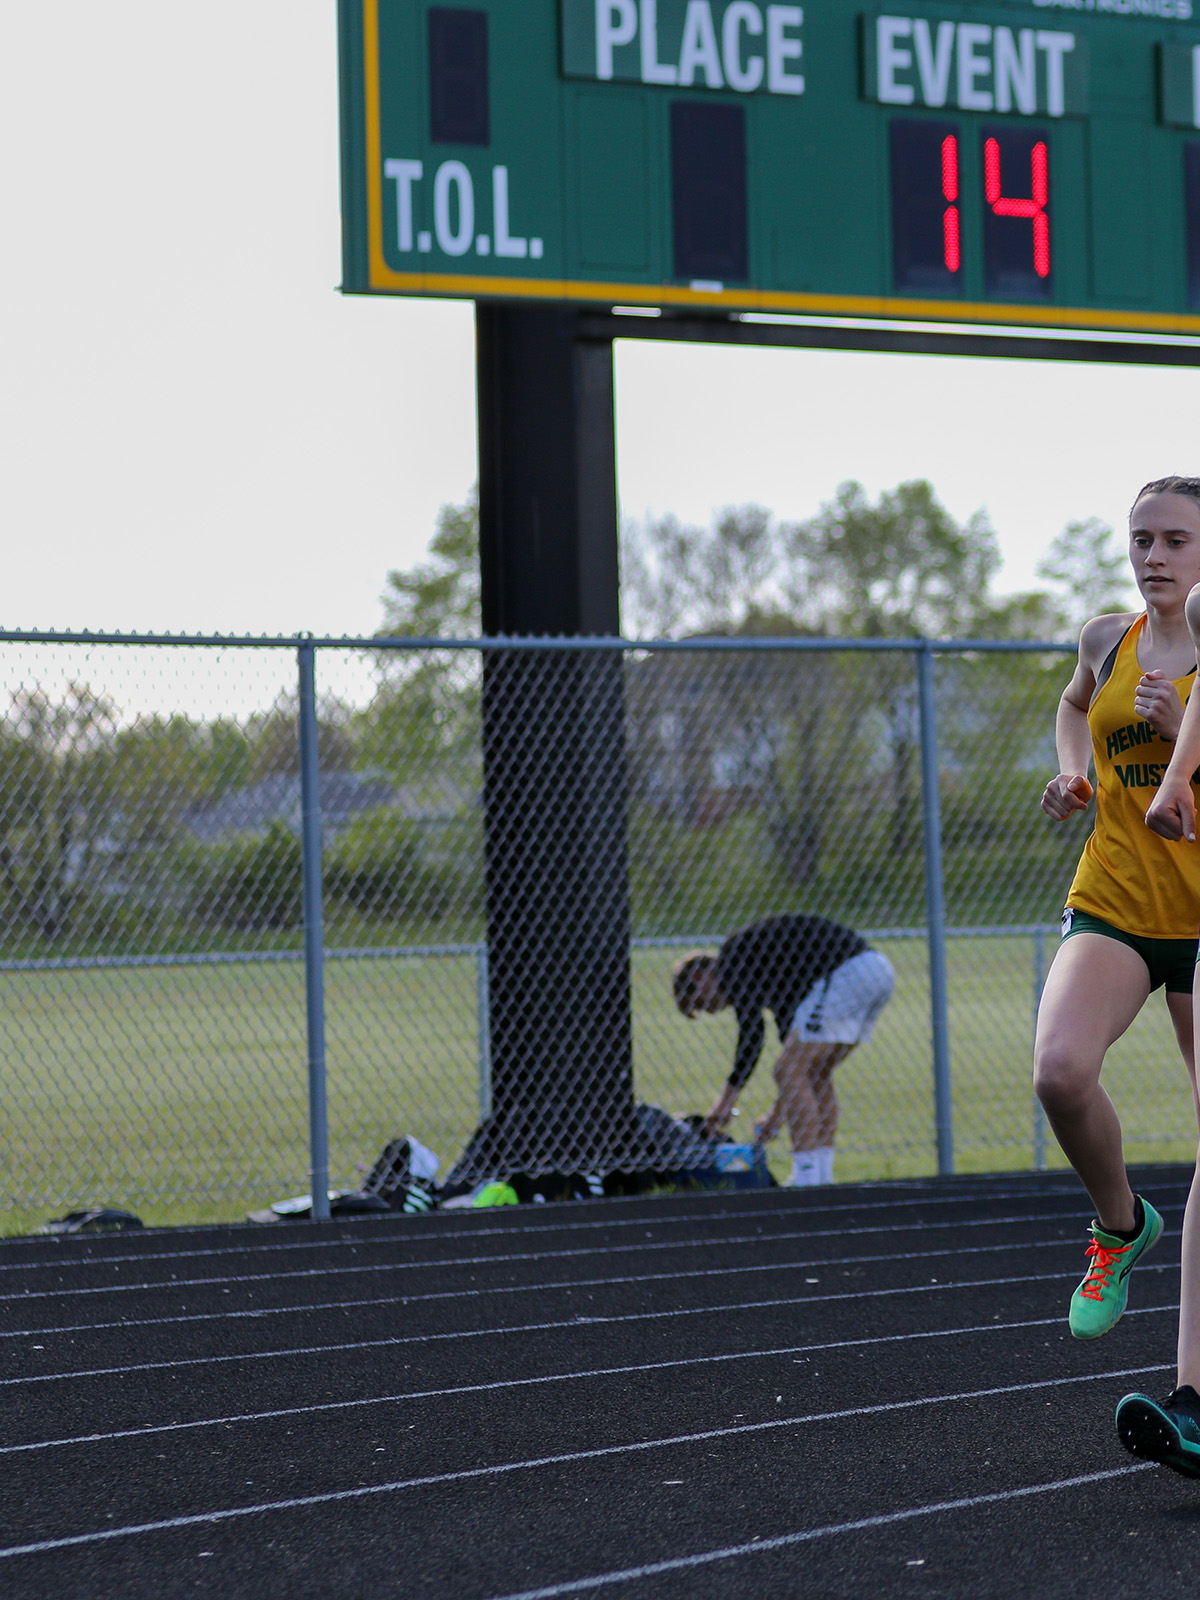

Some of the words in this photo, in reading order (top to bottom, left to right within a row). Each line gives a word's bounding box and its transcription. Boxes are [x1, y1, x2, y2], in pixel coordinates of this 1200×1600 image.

[595, 0, 805, 95] PLACE
[876, 15, 1076, 118] EVENT
[384, 158, 544, 260] T.O.L.
[941, 134, 1049, 278] 14
